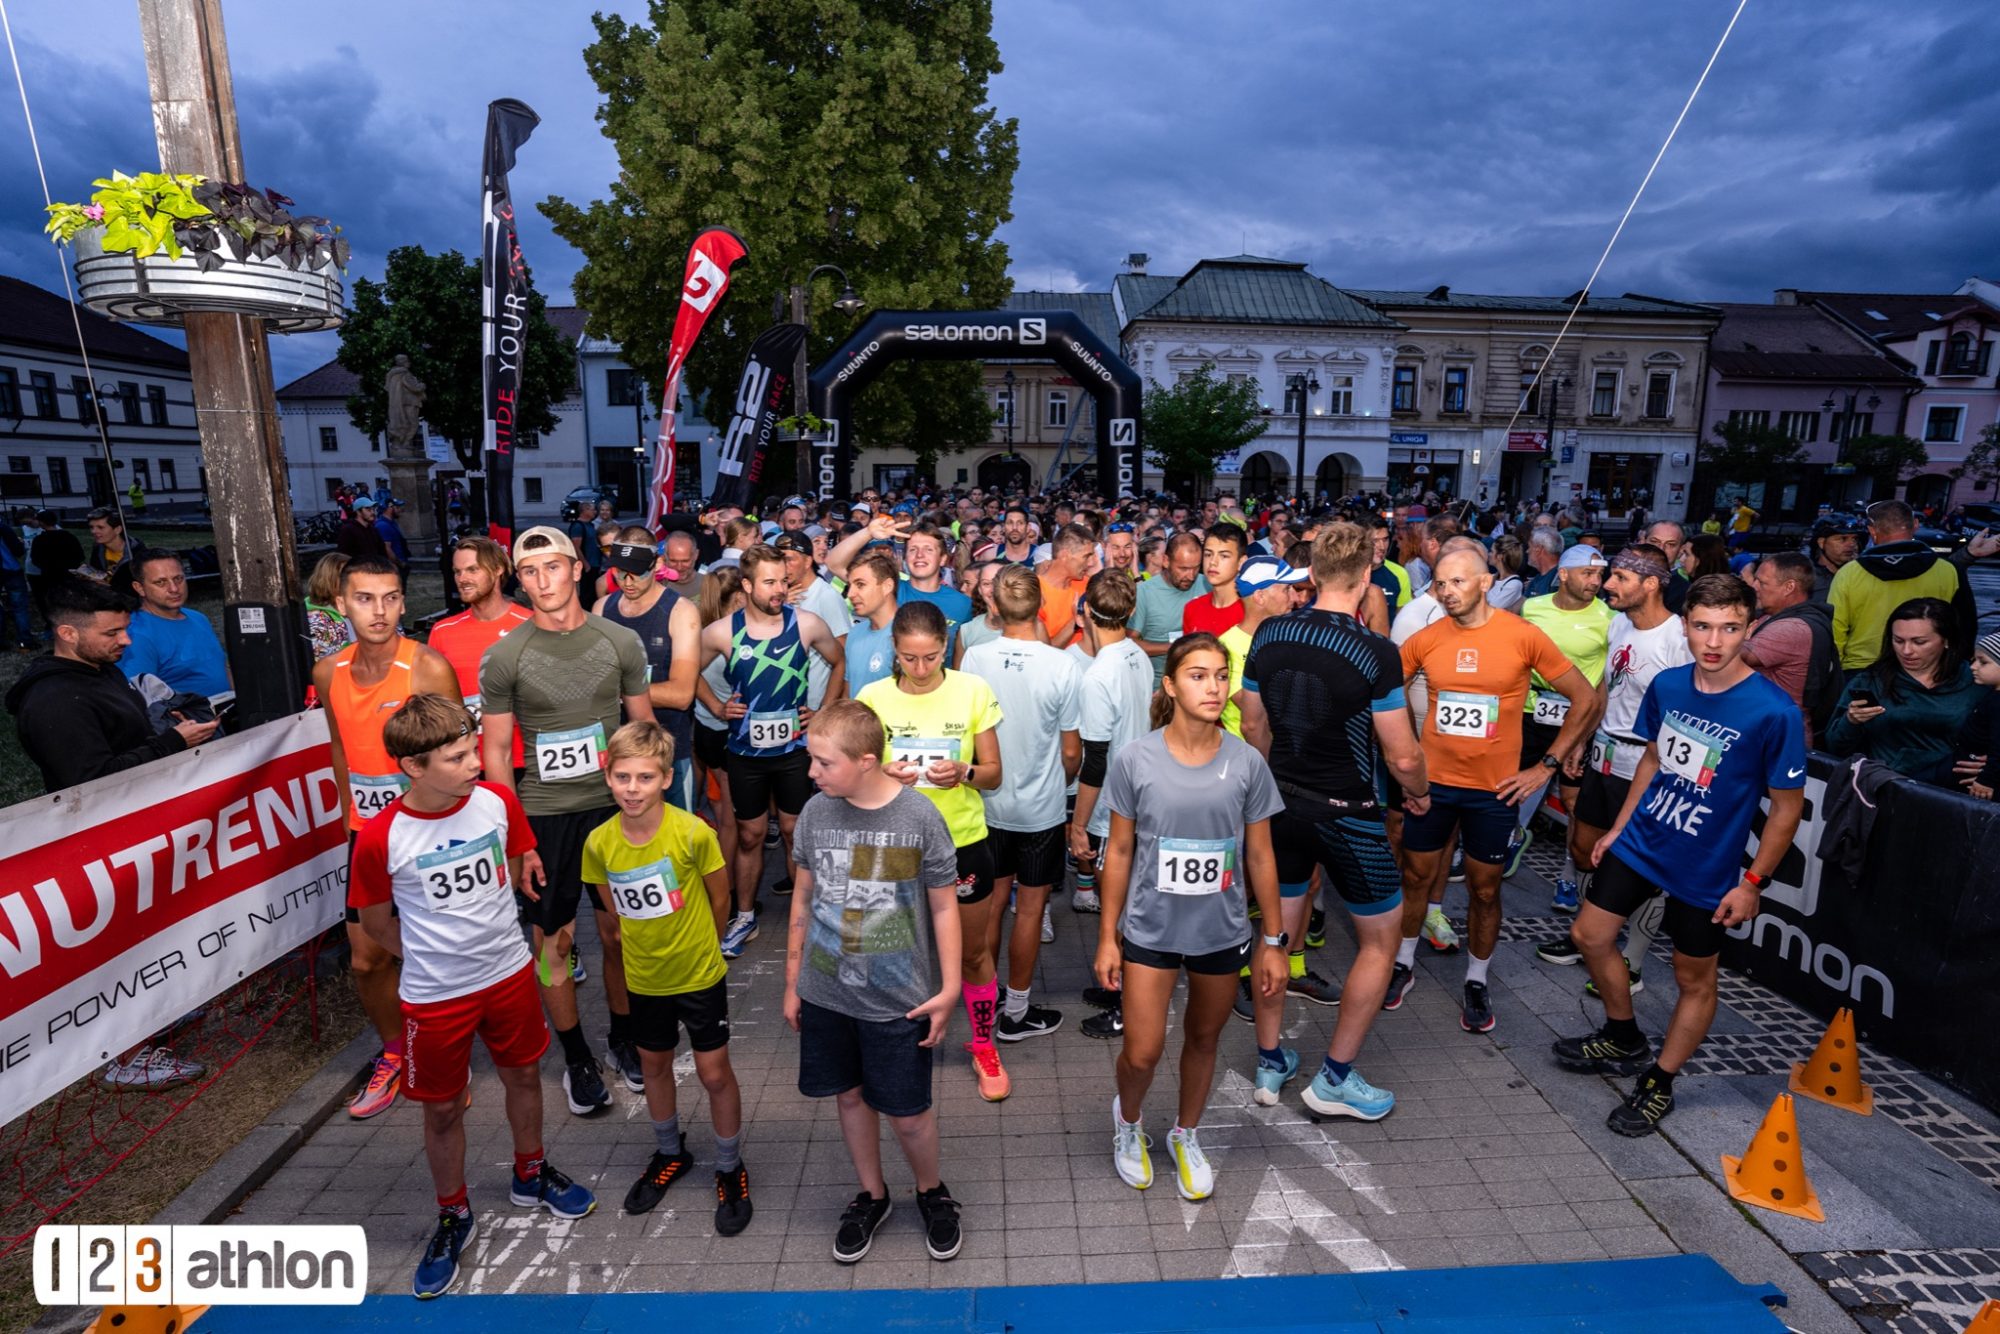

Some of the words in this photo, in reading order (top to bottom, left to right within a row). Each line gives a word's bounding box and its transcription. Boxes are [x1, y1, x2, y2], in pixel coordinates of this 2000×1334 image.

[499, 294, 527, 374] YOUR
[904, 324, 1013, 341] salomon
[837, 340, 880, 381] SUUNTO
[1070, 341, 1112, 382] SUUNTO
[496, 388, 515, 455] RIDE
[748, 450, 766, 482] RIDE
[757, 411, 776, 446] YOUR
[769, 374, 787, 408] RACE
[753, 723, 790, 741] 319
[1440, 706, 1483, 729] 323
[542, 743, 591, 772] 251
[1666, 735, 1692, 766] 13
[355, 789, 397, 811] 248
[1646, 785, 1713, 837] NIKE
[851, 829, 896, 848] STREET
[0, 766, 343, 979] NUTREND
[429, 857, 492, 900] 350
[1165, 856, 1219, 885] 188
[613, 883, 663, 911] 186
[48, 949, 187, 1045] POWER
[197, 921, 237, 958] OF
